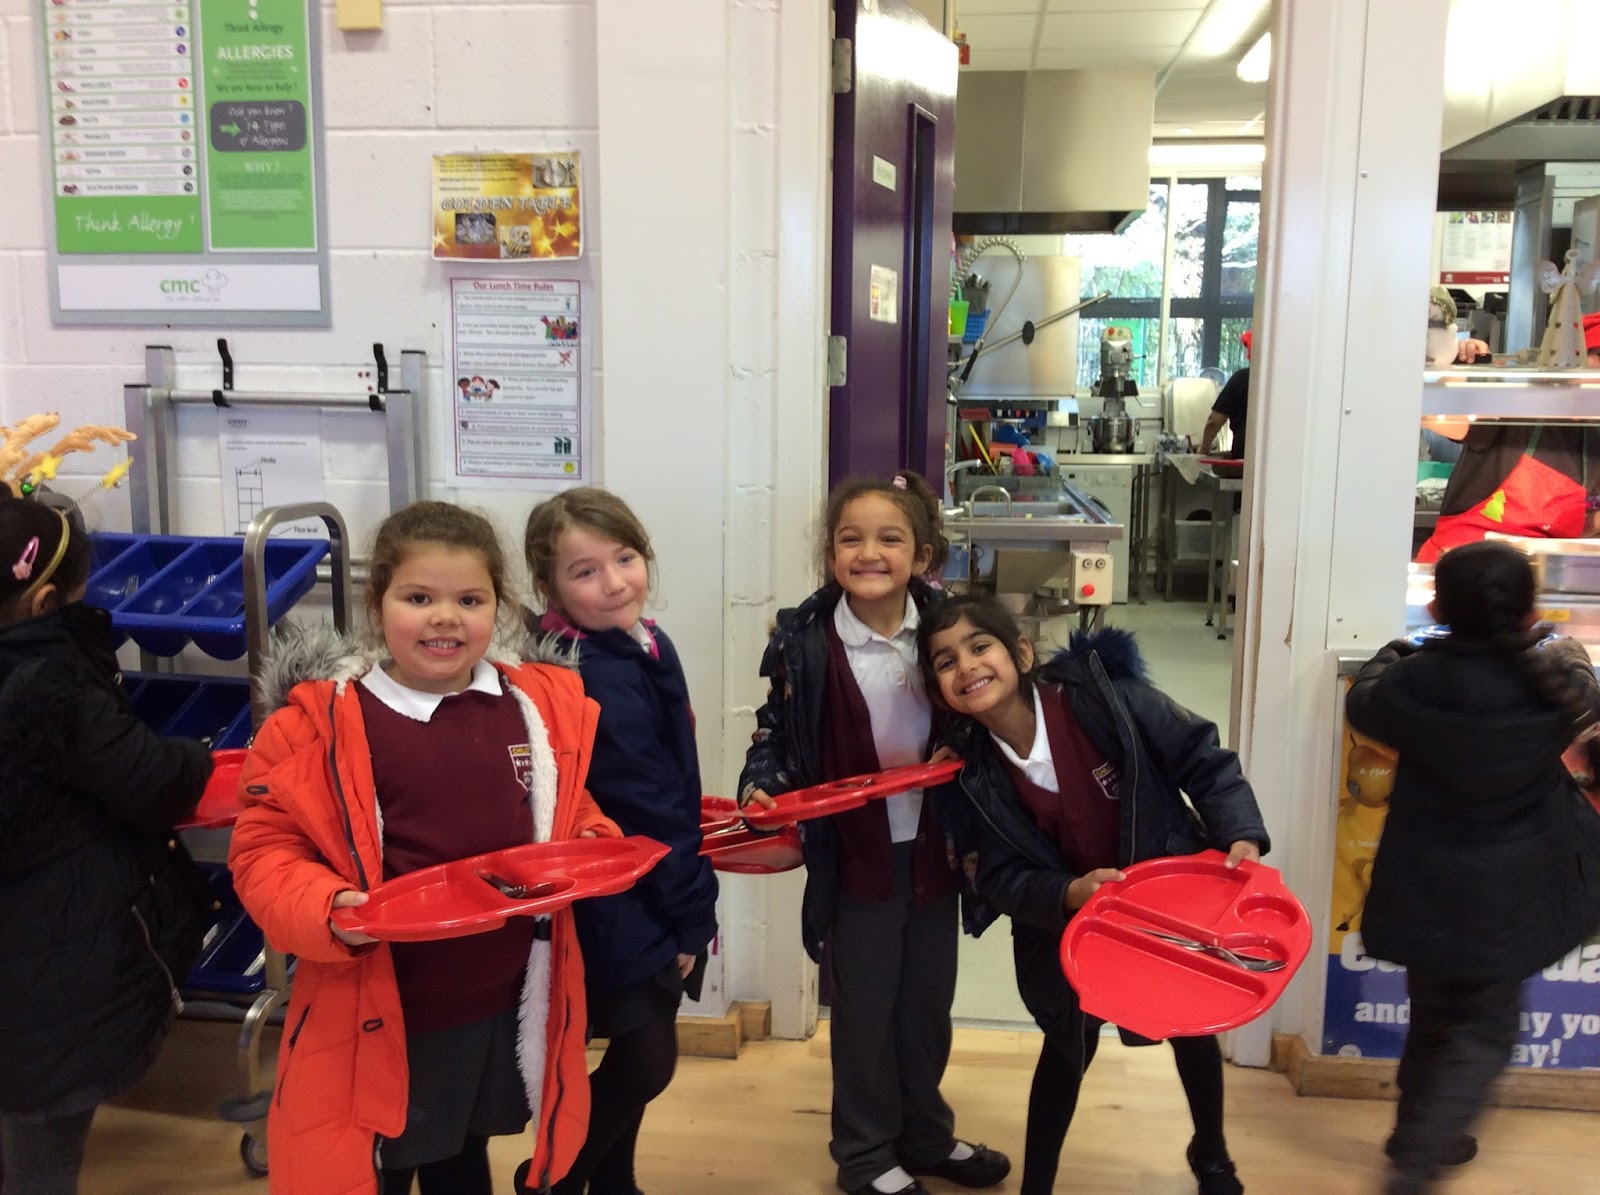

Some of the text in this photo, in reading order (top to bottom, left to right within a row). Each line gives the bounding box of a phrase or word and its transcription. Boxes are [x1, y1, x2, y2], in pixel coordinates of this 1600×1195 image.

[216, 44, 293, 60] ALLERGIES
[441, 196, 573, 215] GOLDEN TABLE
[75, 210, 122, 232] Think
[128, 211, 182, 240] Allergy
[159, 278, 200, 294] cmc
[489, 282, 511, 290] Lunch
[514, 282, 531, 291] Time
[534, 284, 554, 292] Rules
[1354, 997, 1411, 1024] and
